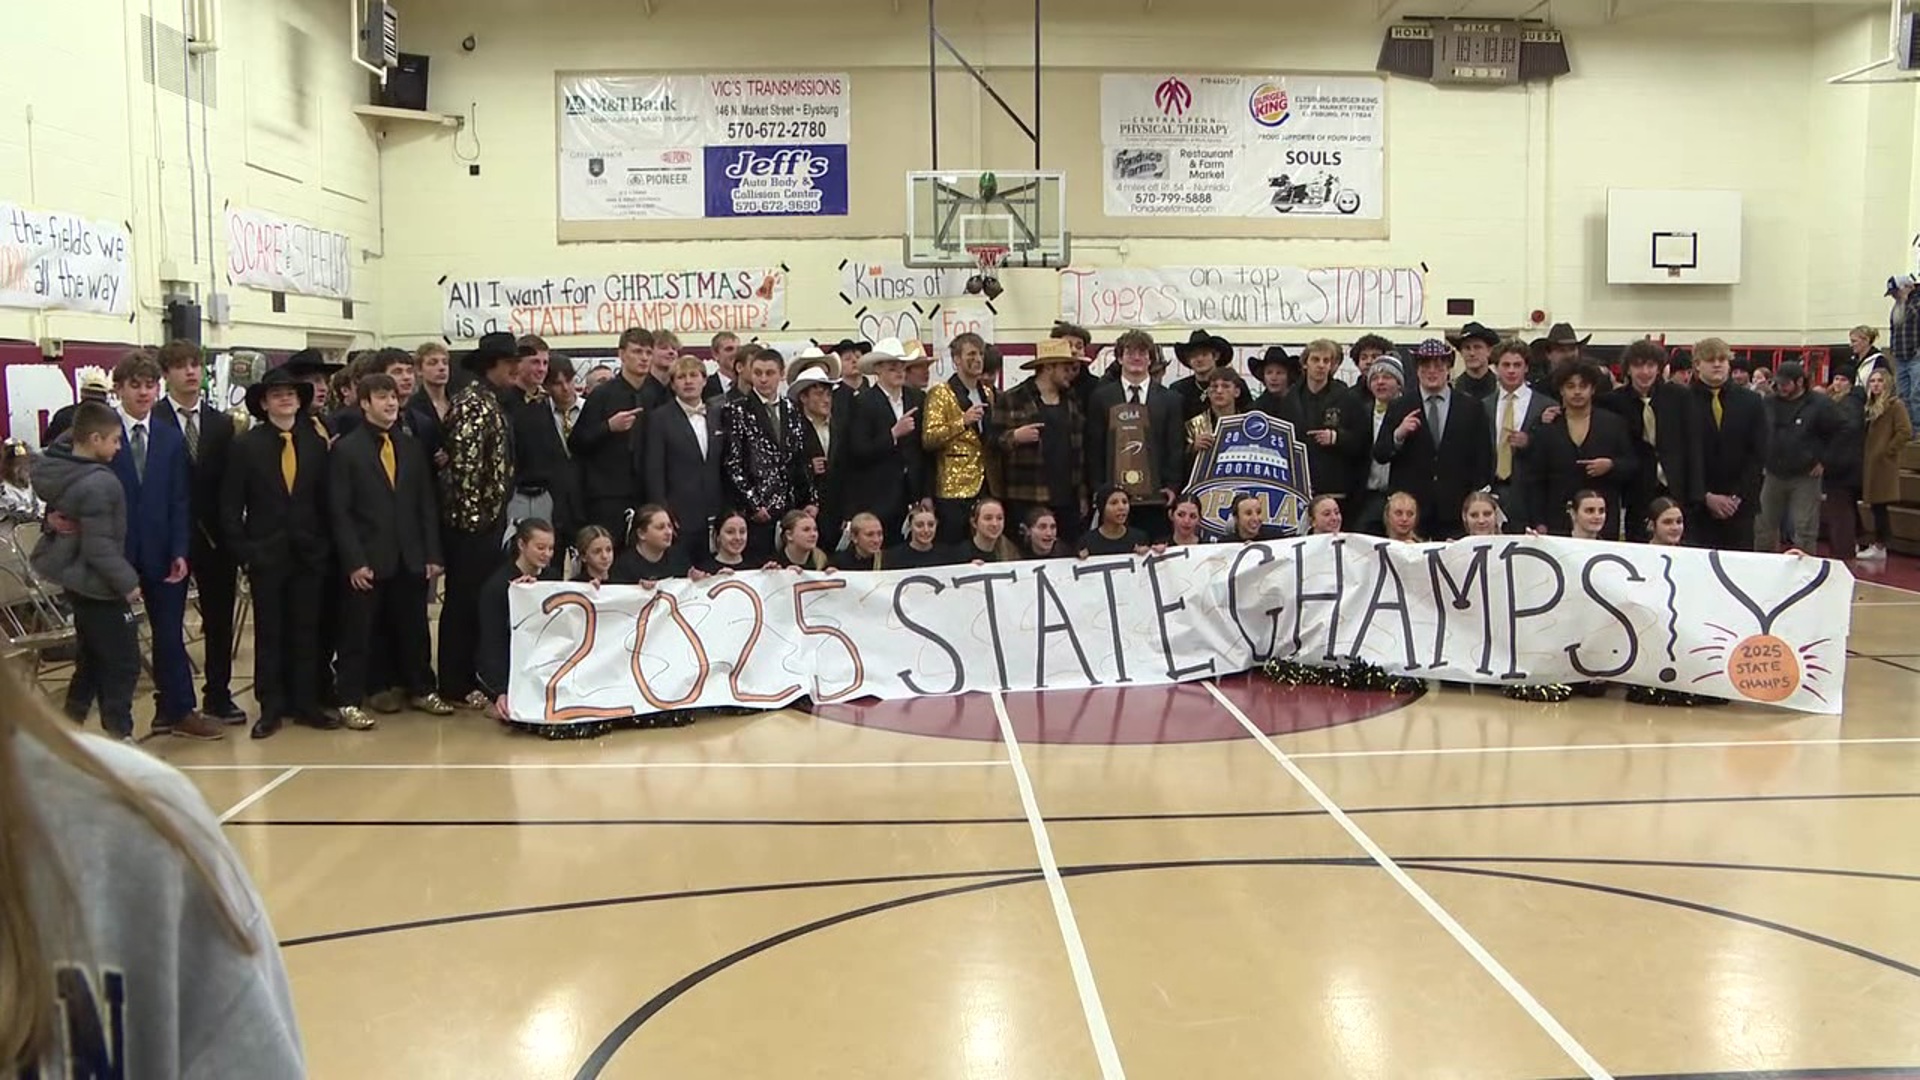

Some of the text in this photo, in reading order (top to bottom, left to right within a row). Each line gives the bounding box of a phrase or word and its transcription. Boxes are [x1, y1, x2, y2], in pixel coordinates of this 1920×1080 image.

[1394, 27, 1430, 37] HOME
[1520, 31, 1558, 41] GUEST
[711, 79, 841, 97] VIC'S TRANSMISSIONS
[631, 96, 677, 111] Bank
[1254, 90, 1287, 106] BURGER
[715, 104, 729, 116] 146
[741, 104, 769, 116] Market
[770, 104, 794, 116] Street
[803, 103, 839, 118] Elysburg
[1255, 99, 1289, 118] KING
[1132, 116, 1182, 124] CENTRAL
[727, 121, 827, 138] 570-672-2780
[1119, 124, 1229, 135] PHYSICAL THERAPY
[1180, 149, 1234, 158] Restaurant
[1285, 150, 1342, 166] SOULS
[727, 150, 828, 177] Jeff's
[1188, 160, 1225, 169] & Farm
[645, 173, 689, 185] PIONEER
[1188, 170, 1225, 179] Market
[742, 177, 811, 188] Auto Body &
[732, 189, 819, 200] Collision Center
[1134, 193, 1213, 203] 570-799-5888
[734, 200, 819, 211] 570-672-9690
[10, 209, 125, 262] the fields we
[231, 213, 282, 275] SCARE
[34, 258, 51, 296] all
[58, 258, 85, 298] the
[87, 272, 120, 313] way
[854, 263, 915, 299] Kings
[923, 267, 946, 296] of
[449, 271, 753, 309] All I want for CHRISTMAS
[1059, 266, 1280, 325] Tigers on top
[1183, 267, 1425, 325] we can't be STOPPED
[454, 314, 475, 339] is
[508, 304, 588, 336] STATE
[1215, 463, 1288, 481] FOOTBALL
[1202, 487, 1299, 527] PAA
[542, 539, 1677, 719] 2025 STATE CHAMPS!
[1741, 644, 1782, 658] 2025
[1736, 661, 1781, 675] STATE
[1739, 676, 1791, 690] CHAMPS
